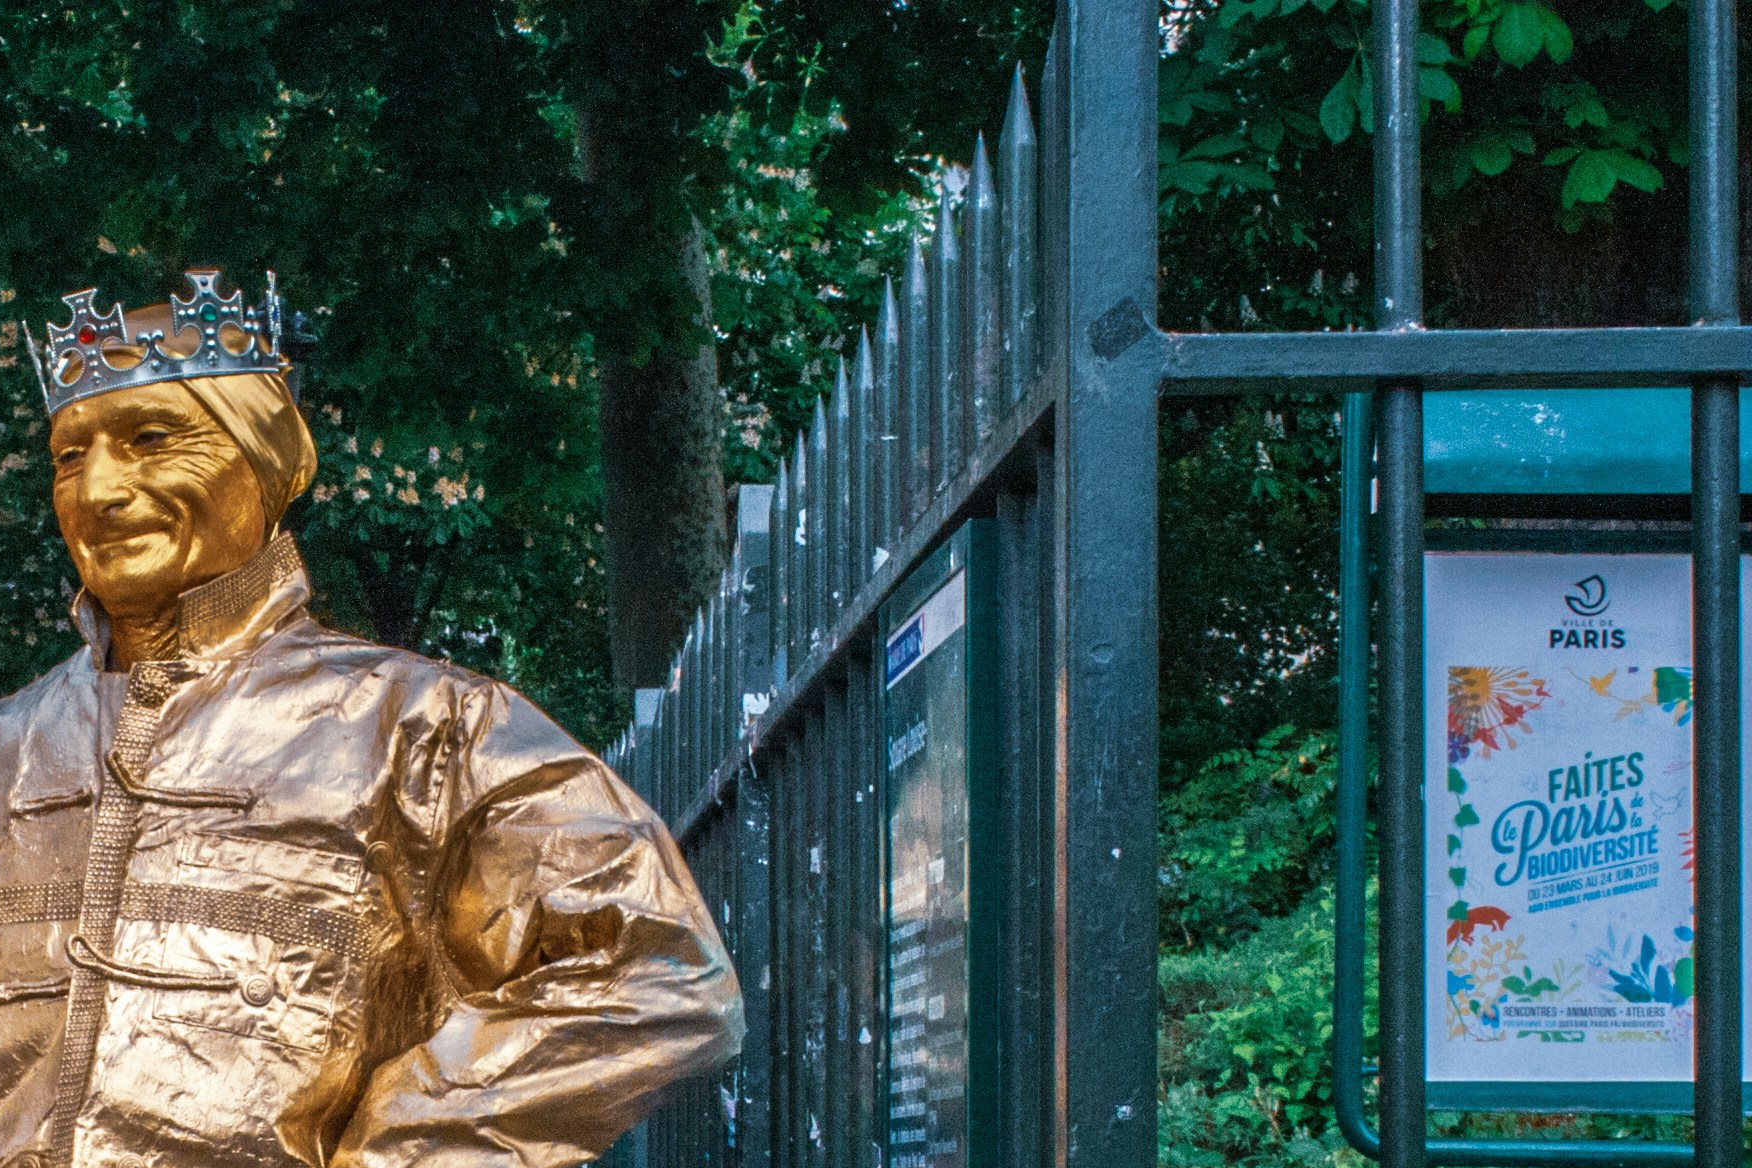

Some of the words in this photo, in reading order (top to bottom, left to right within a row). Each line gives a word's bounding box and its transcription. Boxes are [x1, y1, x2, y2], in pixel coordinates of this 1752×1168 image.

[1561, 619, 1594, 627] VILLE
[1600, 619, 1614, 627] DE
[1549, 629, 1627, 649] PARIS
[1549, 751, 1644, 804] FAITES
[1630, 791, 1644, 809] de
[1503, 818, 1517, 843] le
[1630, 811, 1643, 828] la
[1491, 789, 1628, 887] Paris
[1528, 824, 1659, 880] BIODIVERSITÉ
[1556, 878, 1584, 895] MARS
[1585, 875, 1598, 889] AU
[1600, 871, 1612, 886] 24
[1503, 1006, 1557, 1017] RENCONTRES
[1566, 1006, 1617, 1017] ANIMATIONS
[1625, 1006, 1666, 1017] ATELIERS
